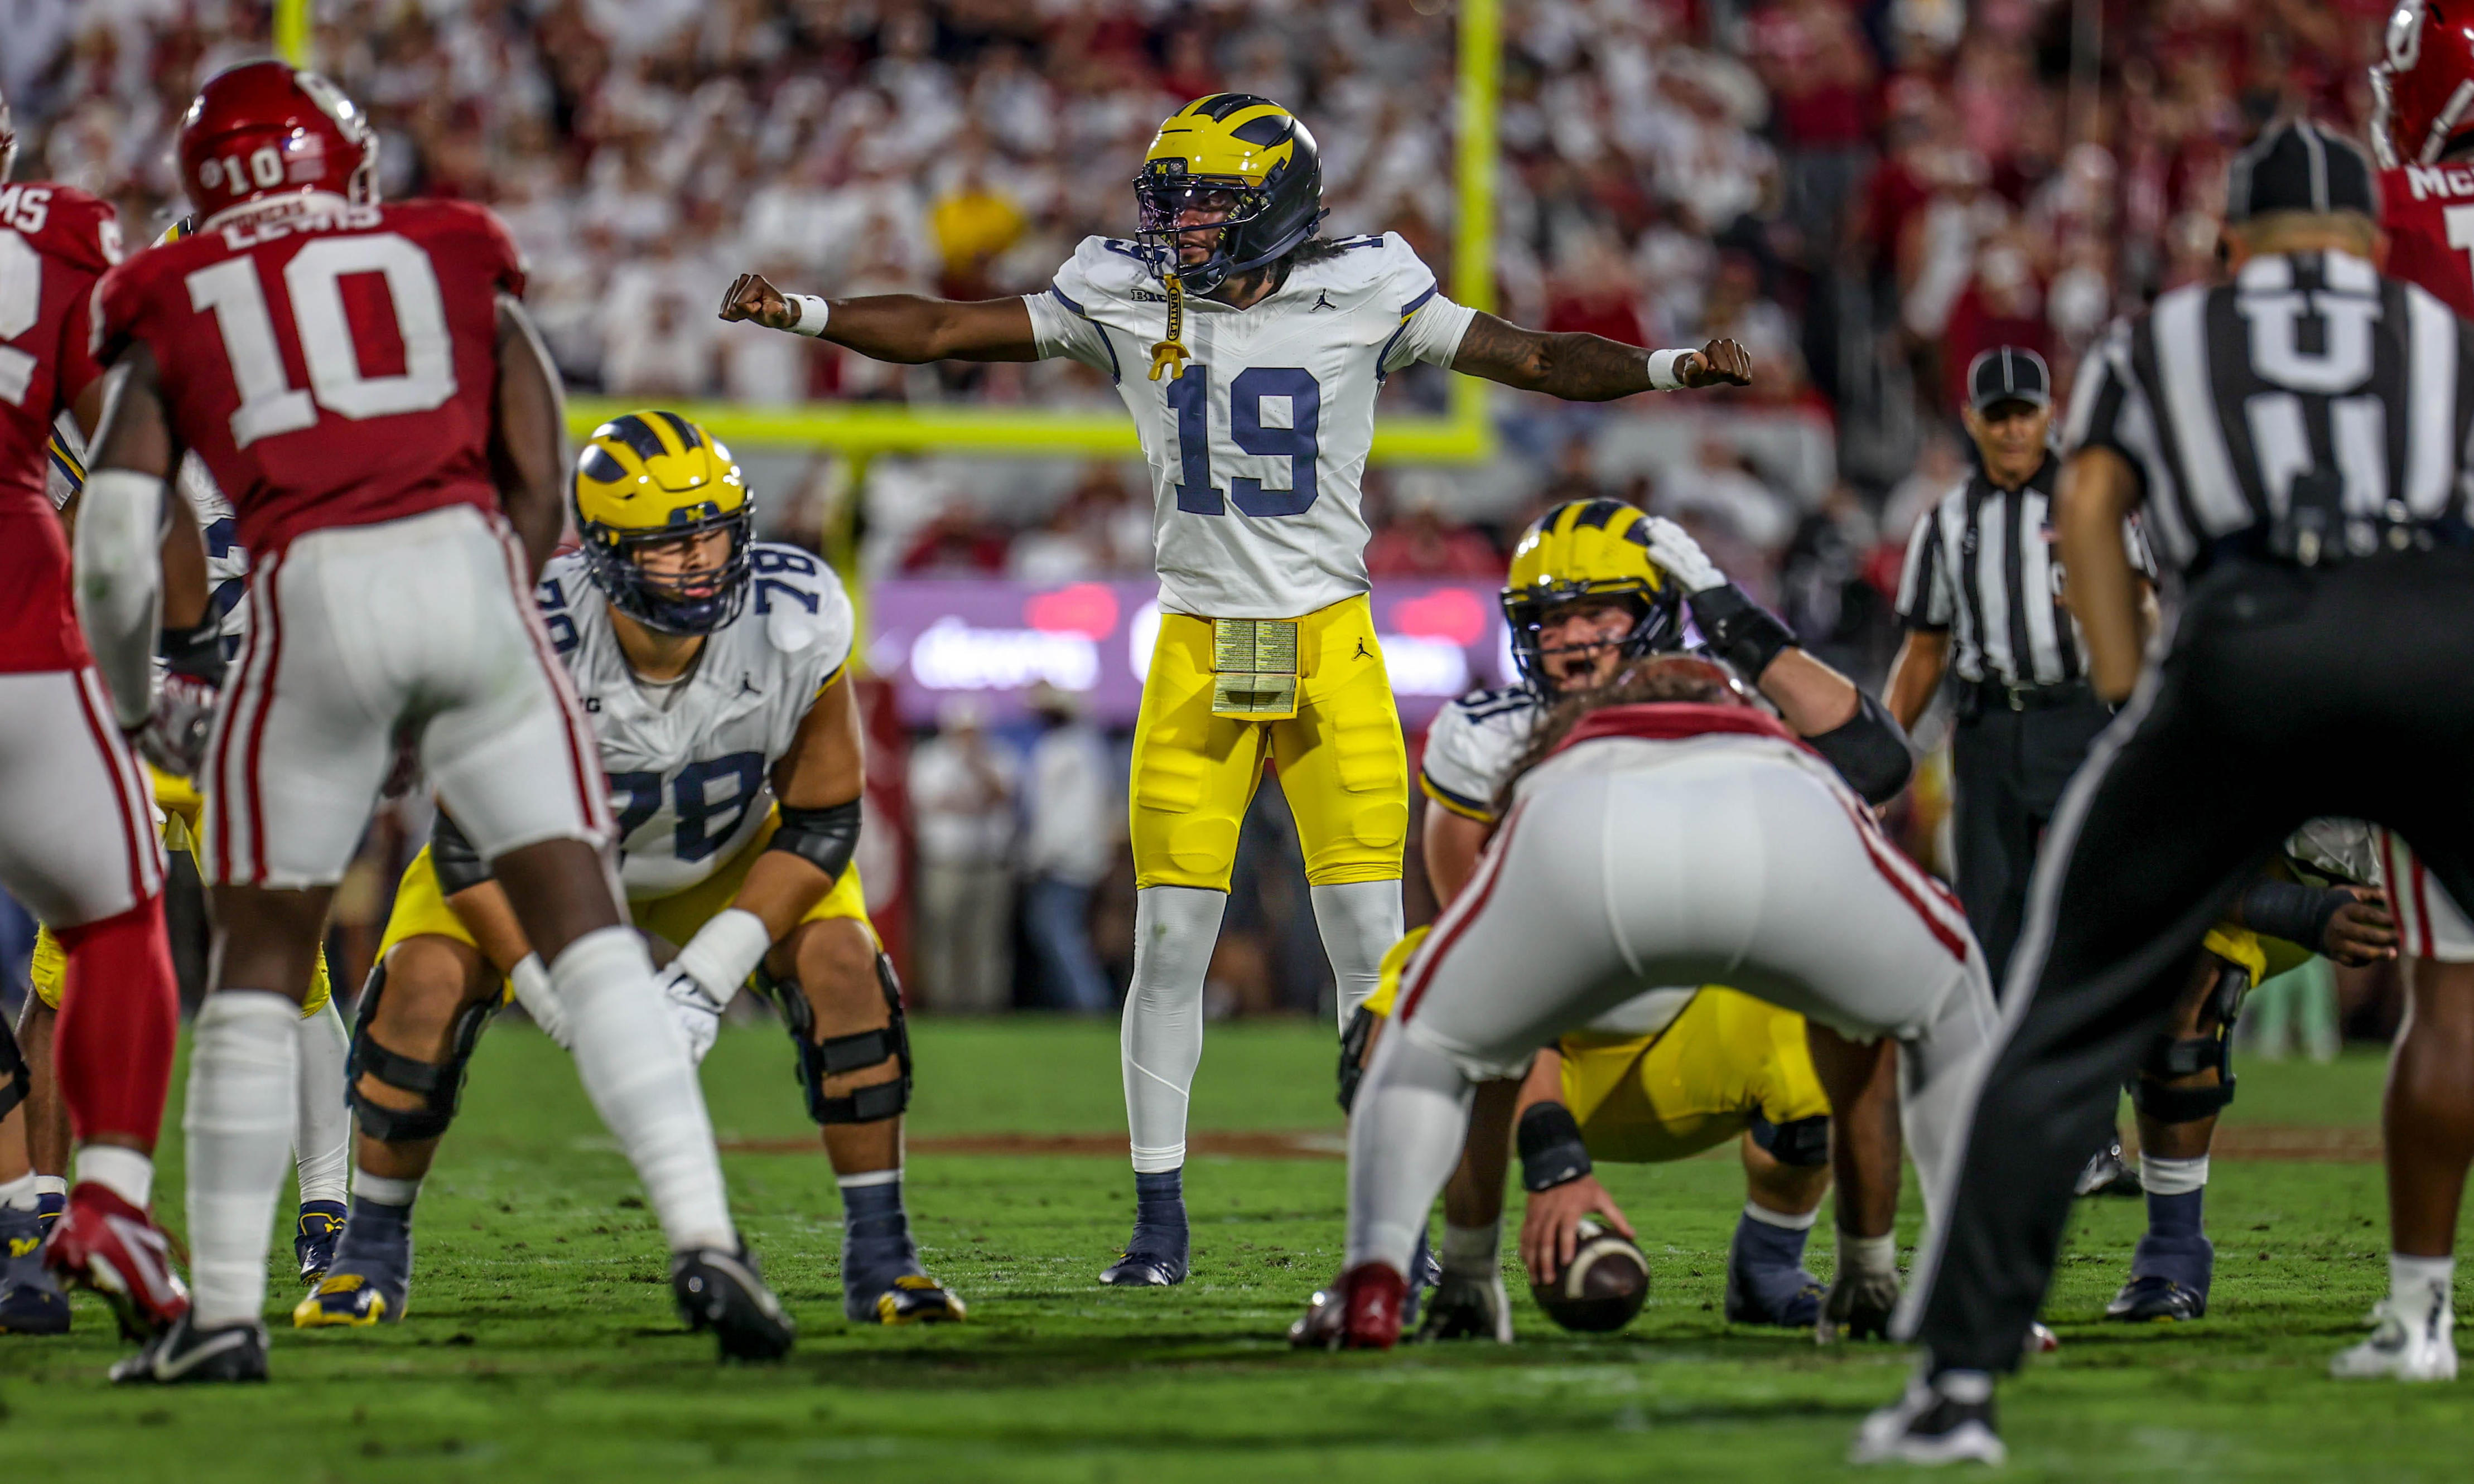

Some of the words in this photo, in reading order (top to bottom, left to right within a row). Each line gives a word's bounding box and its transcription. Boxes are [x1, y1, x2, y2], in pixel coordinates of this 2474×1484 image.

[223, 146, 284, 195] 10
[185, 232, 458, 449] 10
[1170, 292, 1179, 336] BATTLE
[1166, 365, 1321, 518] 19
[750, 549, 820, 616] 78
